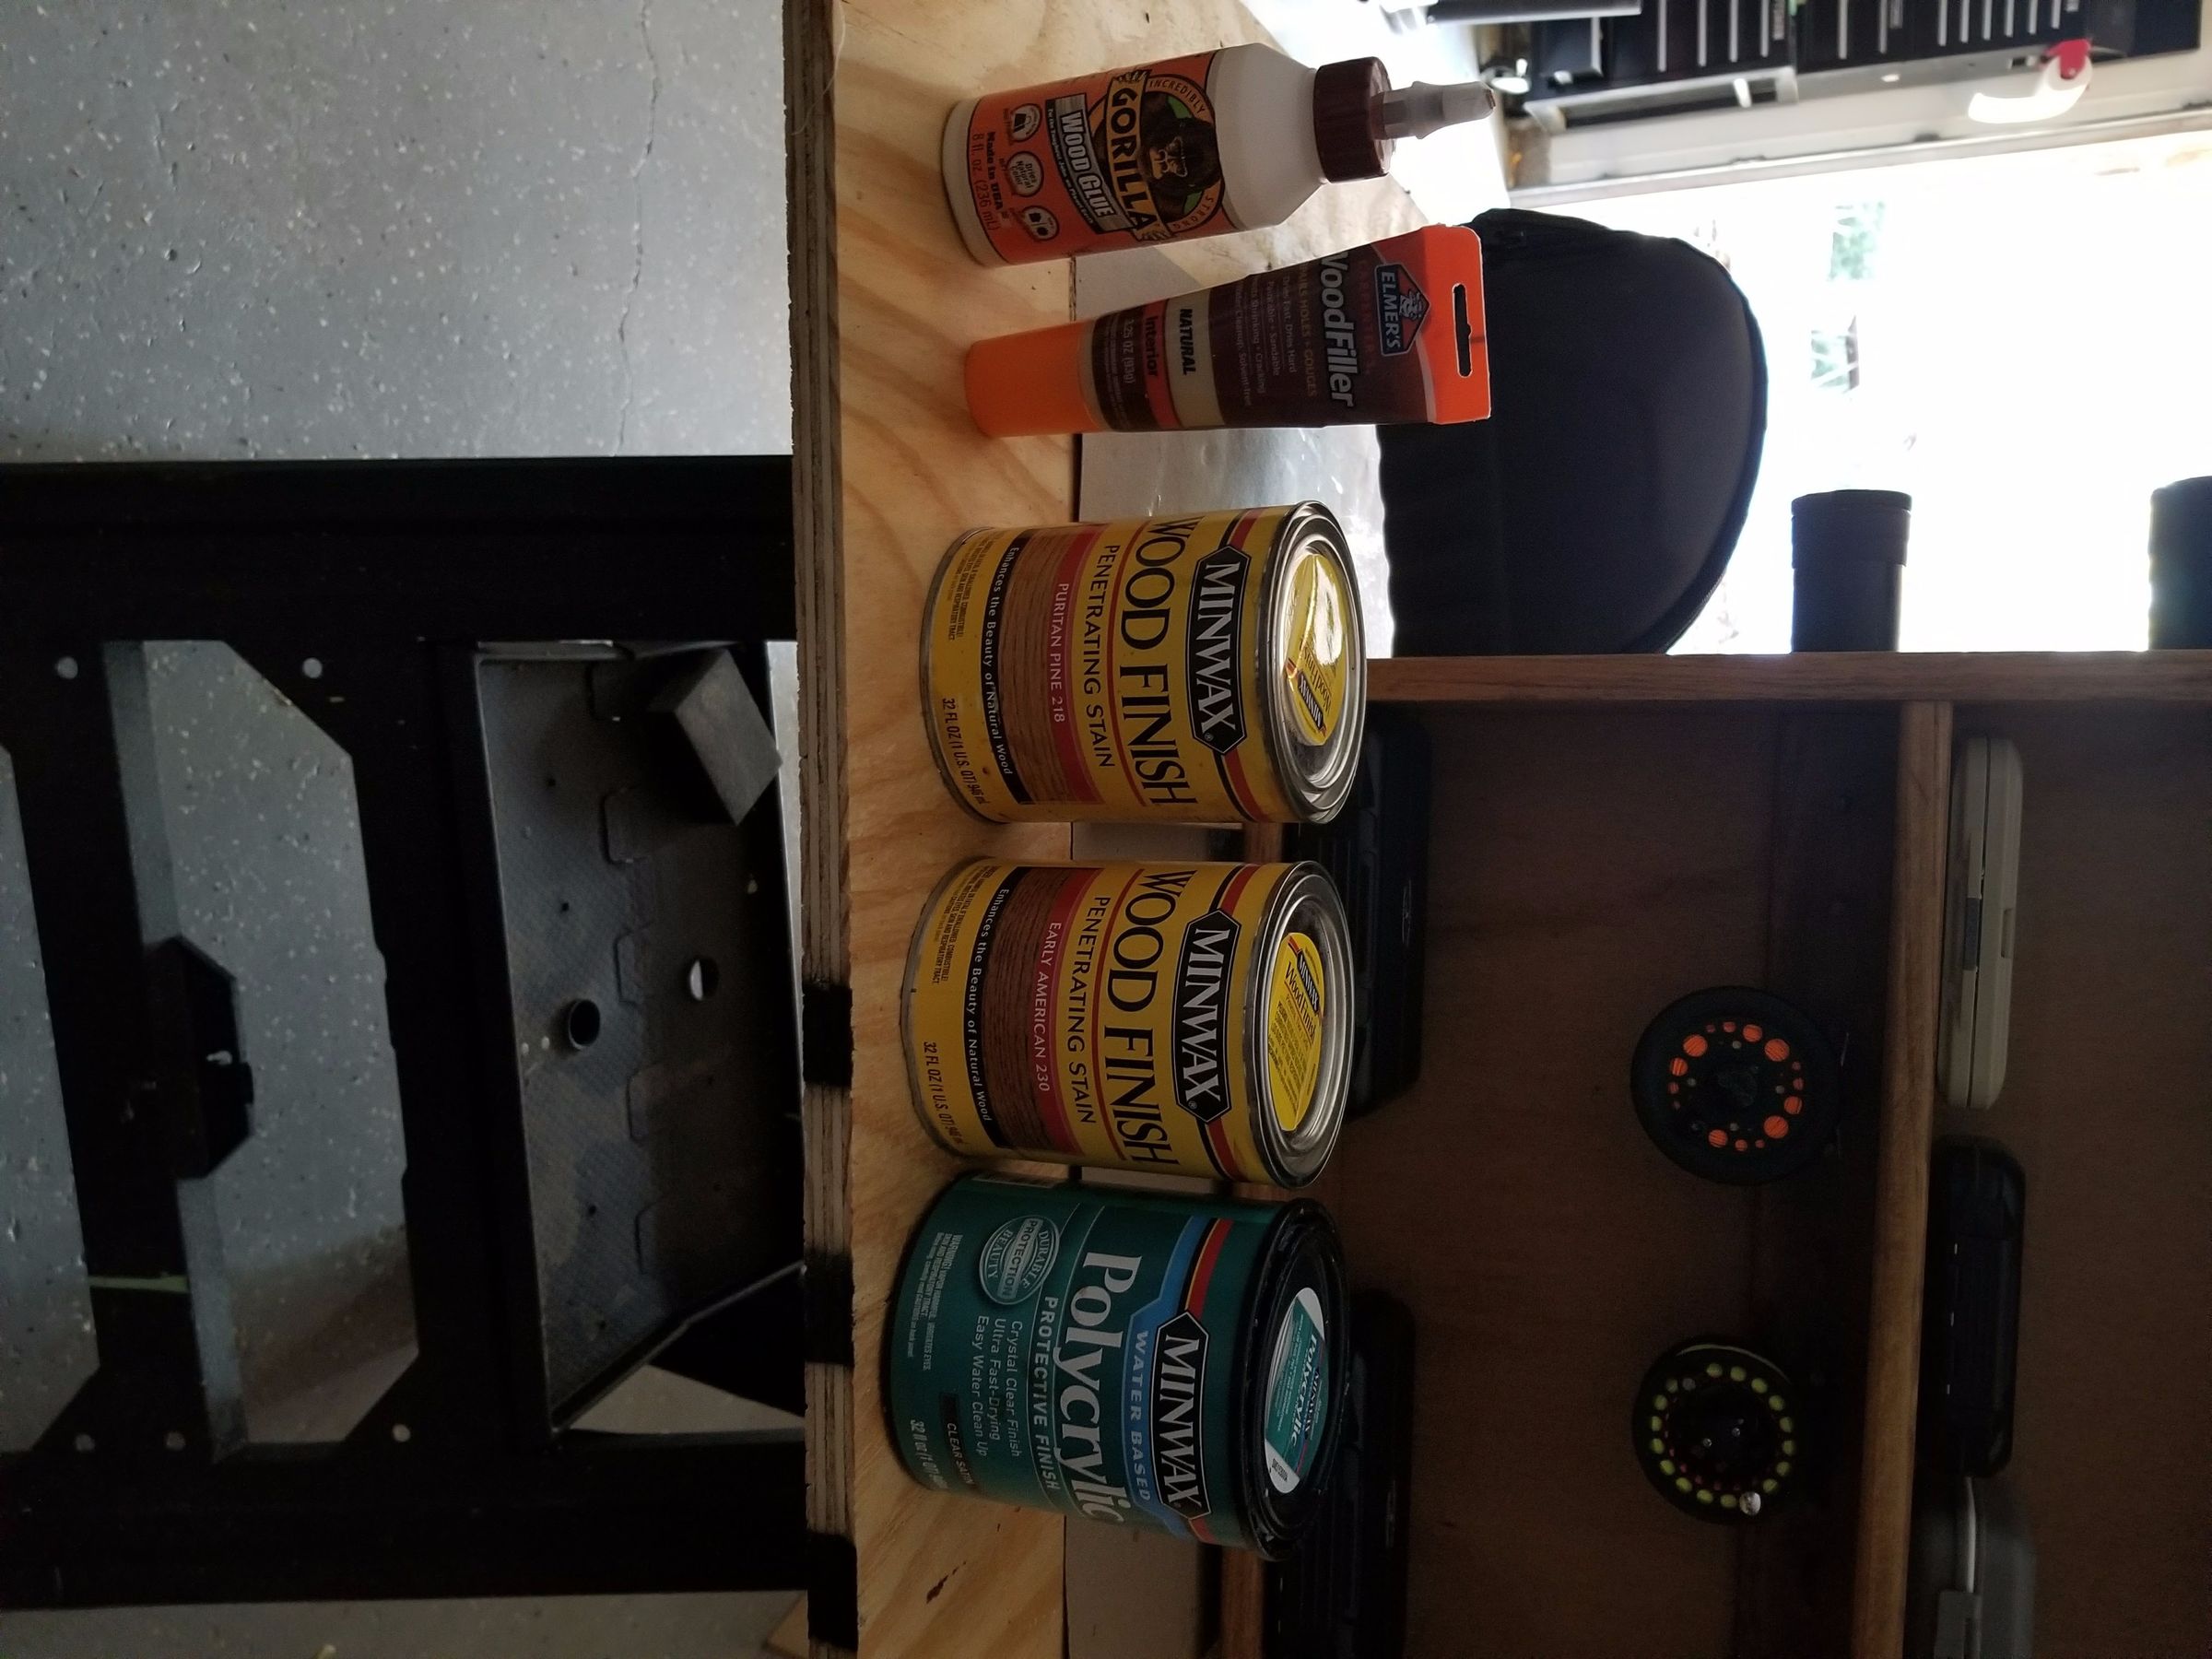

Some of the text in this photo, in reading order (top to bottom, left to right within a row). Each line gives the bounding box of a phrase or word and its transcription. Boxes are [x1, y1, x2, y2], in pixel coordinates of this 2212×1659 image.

[1148, 80, 1206, 115] INCREDIBLY
[1016, 160, 1032, 189] Natural
[1111, 88, 1157, 230] GORILLA
[1172, 194, 1215, 230] STRONG
[1298, 263, 1317, 397] PAIRS HOLES GOUGES
[1381, 271, 1401, 348] ELMER'S
[1145, 315, 1159, 377] Interior
[1180, 308, 1196, 375] NATURAL
[1269, 333, 1281, 376] Sandable
[1253, 353, 1266, 394] Cracking
[982, 547, 1020, 775] Enhances the Beauty of Natural Wood
[1050, 582, 1070, 723] PURITAN PINE 218
[1083, 545, 1122, 768] PENETRATING STAIN
[1120, 517, 1206, 806] WOOD FINISH
[1194, 560, 1241, 736] MINWAX
[942, 698, 956, 710] 32
[945, 712, 958, 724] FL
[1298, 674, 1324, 728] MINWAX
[947, 726, 962, 739] OZ
[953, 751, 970, 769] U.S.
[981, 888, 1010, 937] Enhances
[973, 942, 989, 963] the
[965, 968, 982, 1015] Beauty
[1032, 922, 1061, 1091] EARLY AMERICAN 230
[1067, 897, 1112, 1124] PENETRATING STAIN
[1297, 953, 1320, 1012] MINWAX
[967, 1020, 980, 1034] of
[1104, 870, 1197, 1165] WOOD FINISH
[1181, 927, 1230, 1103] MINWAX
[924, 1041, 937, 1053] 32
[925, 1055, 939, 1066] FL
[968, 1039, 983, 1087] Natural
[927, 1069, 942, 1083] OZ
[929, 1084, 944, 1092] (1
[932, 1095, 948, 1112] U.S.
[975, 1090, 994, 1122] Wood
[941, 1234, 964, 1270] WARNING!
[987, 1230, 1014, 1278] BEAUTY
[1002, 1219, 1038, 1296] PROTECTION
[1020, 1230, 1050, 1288] DURABLE
[971, 1315, 990, 1457] Easy Water Clean Up
[987, 1318, 1006, 1441] Ultra Fast-Drying
[1006, 1321, 1023, 1457] Crystal Clear Finish
[1032, 1296, 1060, 1490] PROTECTIVE FINISH
[1053, 1251, 1143, 1523] Polycrylic
[1290, 1334, 1317, 1448] Polycrylic
[910, 1419, 925, 1433] 32
[947, 1422, 962, 1459] CLEAR
[1130, 1330, 1151, 1501] WATER BASED
[1159, 1334, 1202, 1508] MINWAX
